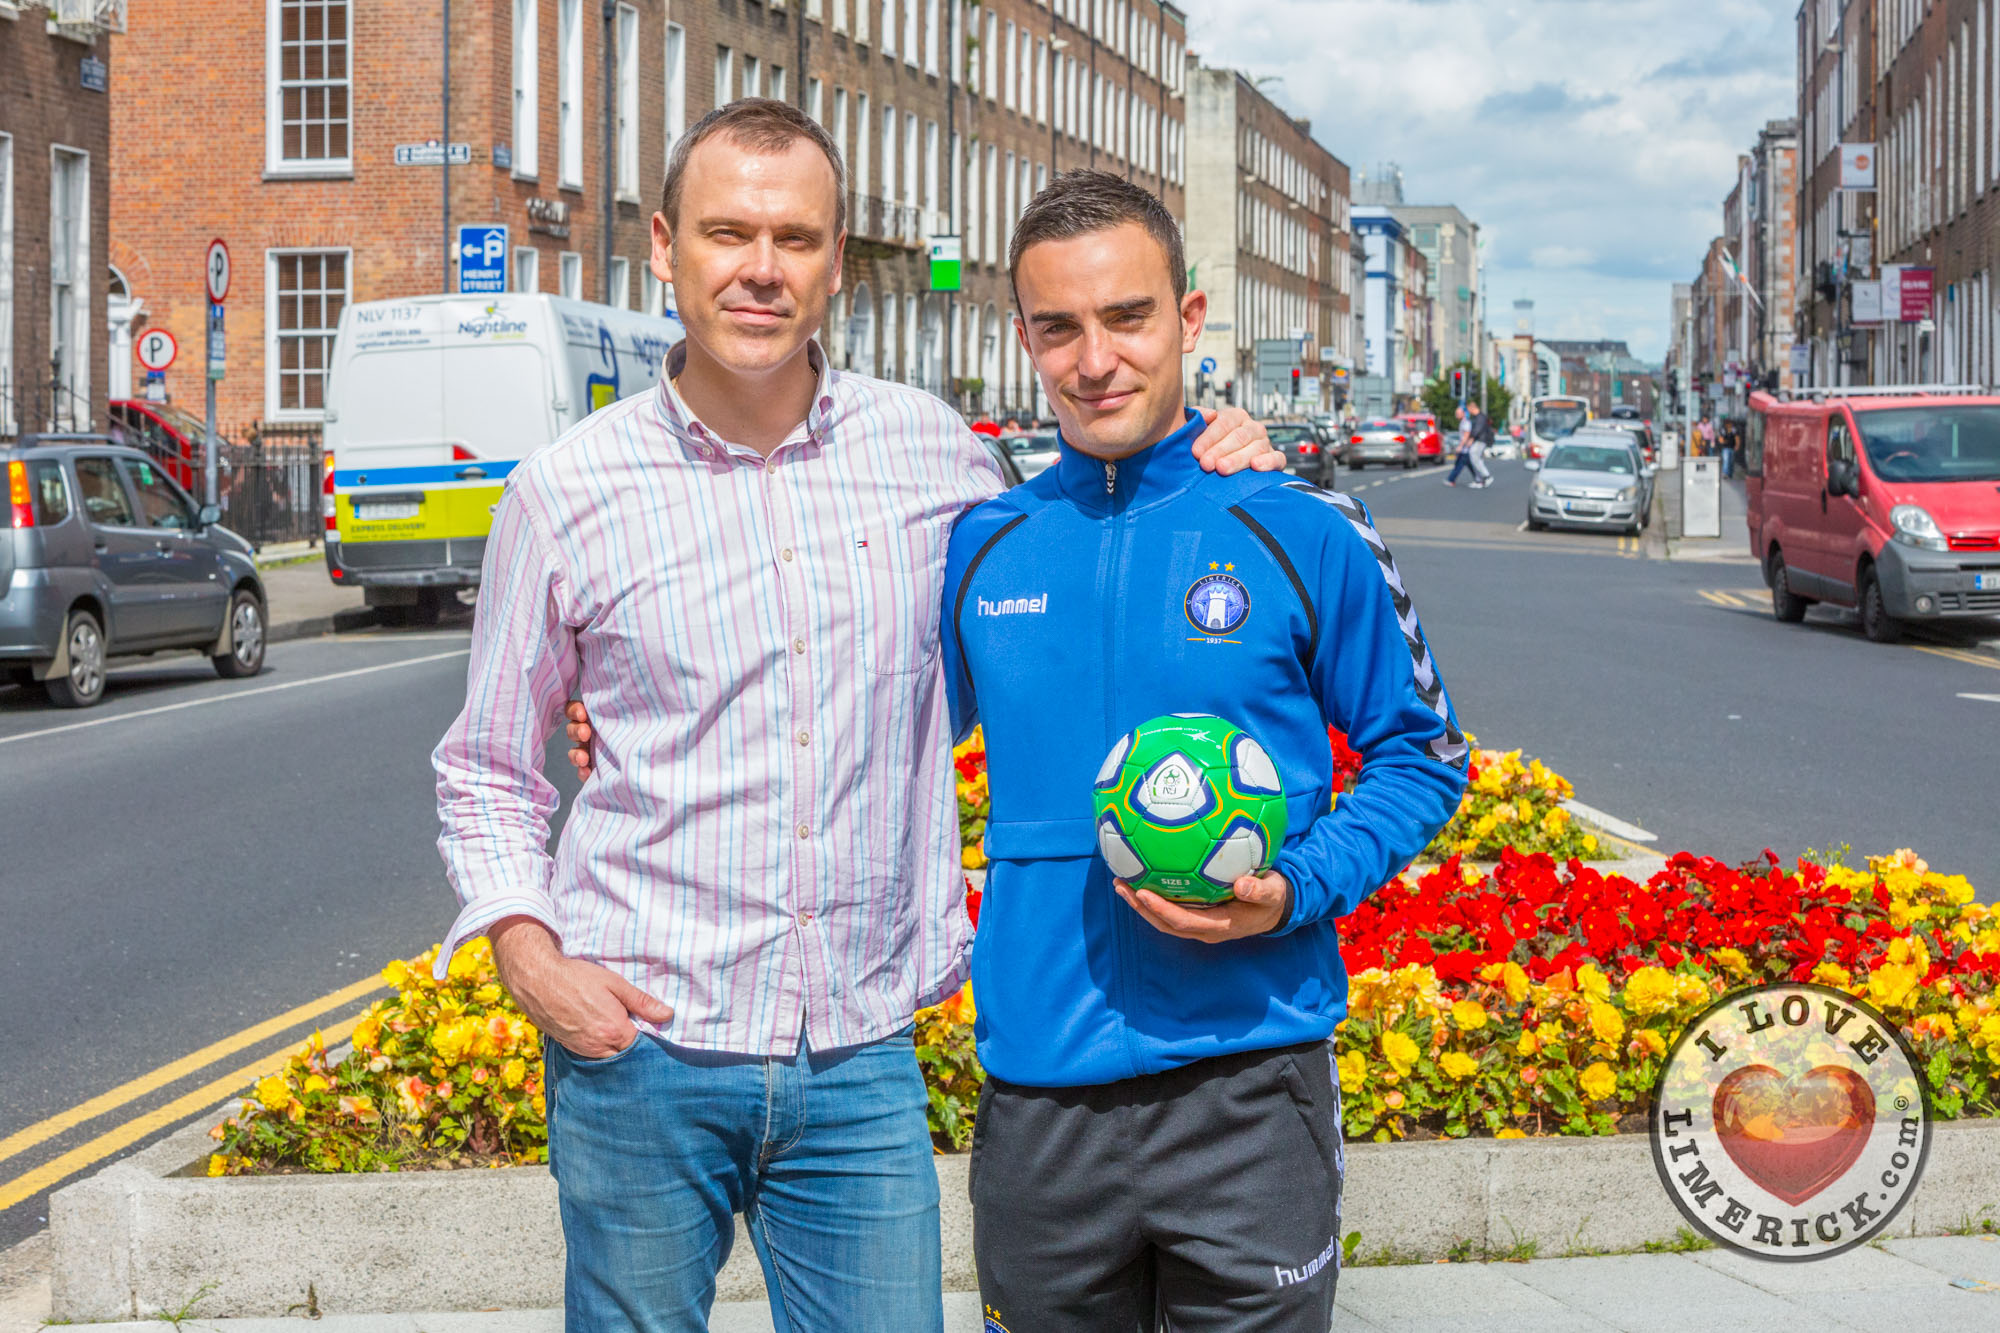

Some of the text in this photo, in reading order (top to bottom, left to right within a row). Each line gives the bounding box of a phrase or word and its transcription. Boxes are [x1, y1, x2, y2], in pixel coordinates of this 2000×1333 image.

[462, 269, 502, 279] HENRY
[462, 280, 503, 290] STREET
[357, 307, 422, 323] NLV 1137
[457, 320, 528, 338] Nightline
[150, 336, 163, 363] P
[351, 522, 426, 533] EXPRESS DELIVERY
[1199, 575, 1241, 588] LIMERICK
[977, 593, 1048, 616] hummel
[1160, 878, 1183, 886] SIZE
[1274, 1235, 1335, 1287] hummel
